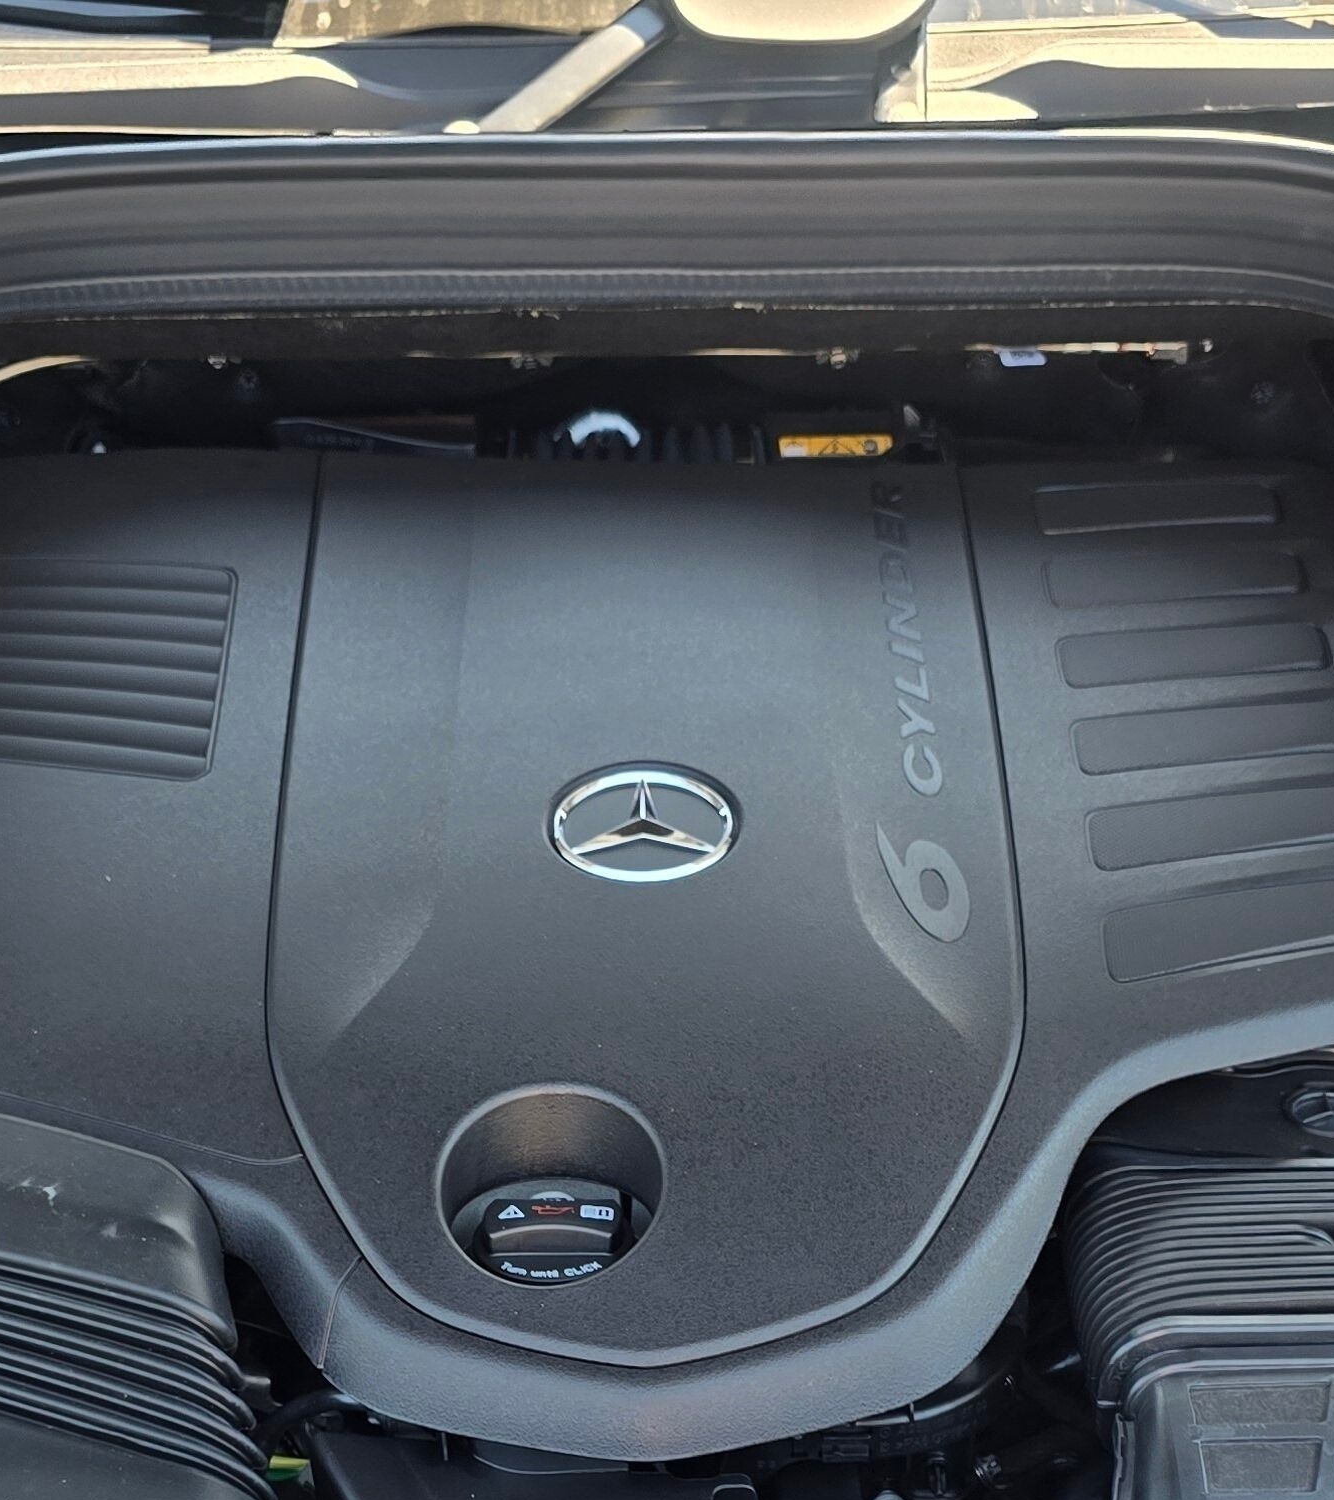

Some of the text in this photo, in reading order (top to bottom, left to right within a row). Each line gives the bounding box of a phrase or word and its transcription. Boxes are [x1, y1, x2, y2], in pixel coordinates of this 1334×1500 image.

[871, 478, 971, 944] 6 CYLINDER
[563, 1260, 603, 1277] CLICK
